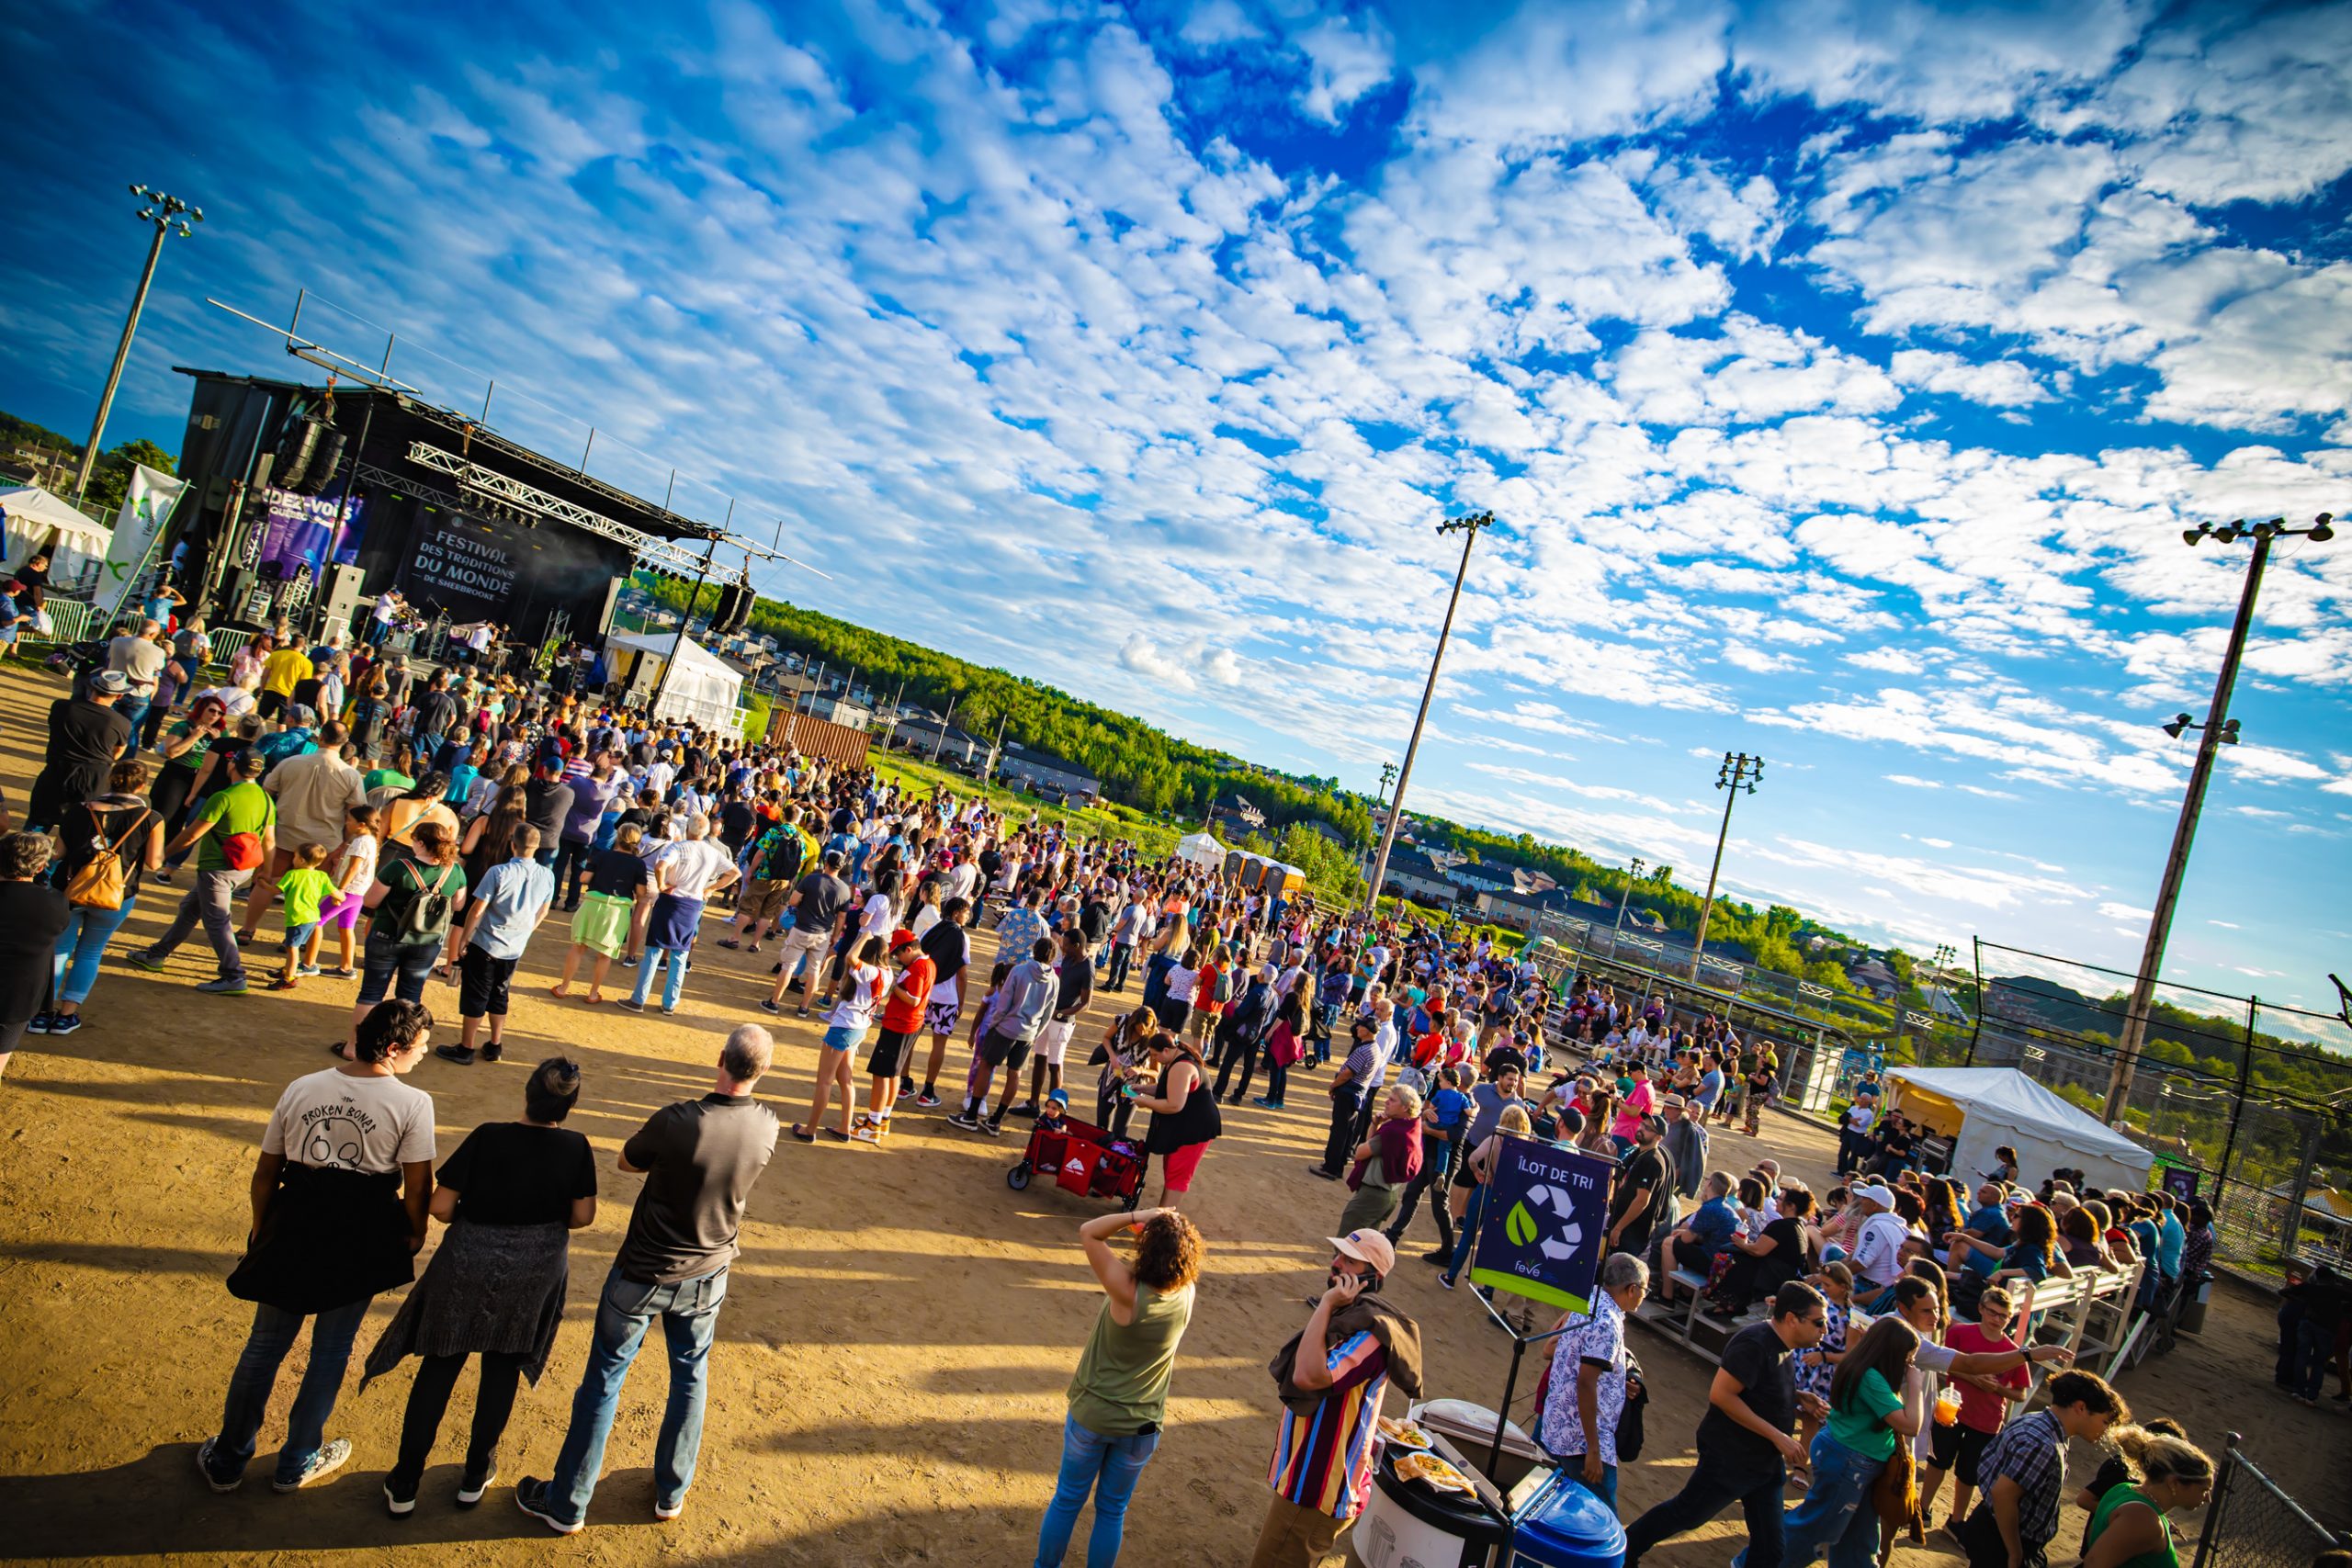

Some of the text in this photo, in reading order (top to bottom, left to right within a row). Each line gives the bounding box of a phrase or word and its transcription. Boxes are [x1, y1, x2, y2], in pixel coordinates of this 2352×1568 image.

[420, 542, 515, 580] DES TRADITIONS
[435, 529, 508, 565] FESTIVAL
[414, 555, 513, 595] DU MONDE
[424, 574, 496, 602] DE SHERBROOKE
[1518, 1155, 1594, 1190] ÎLOT DE TRI
